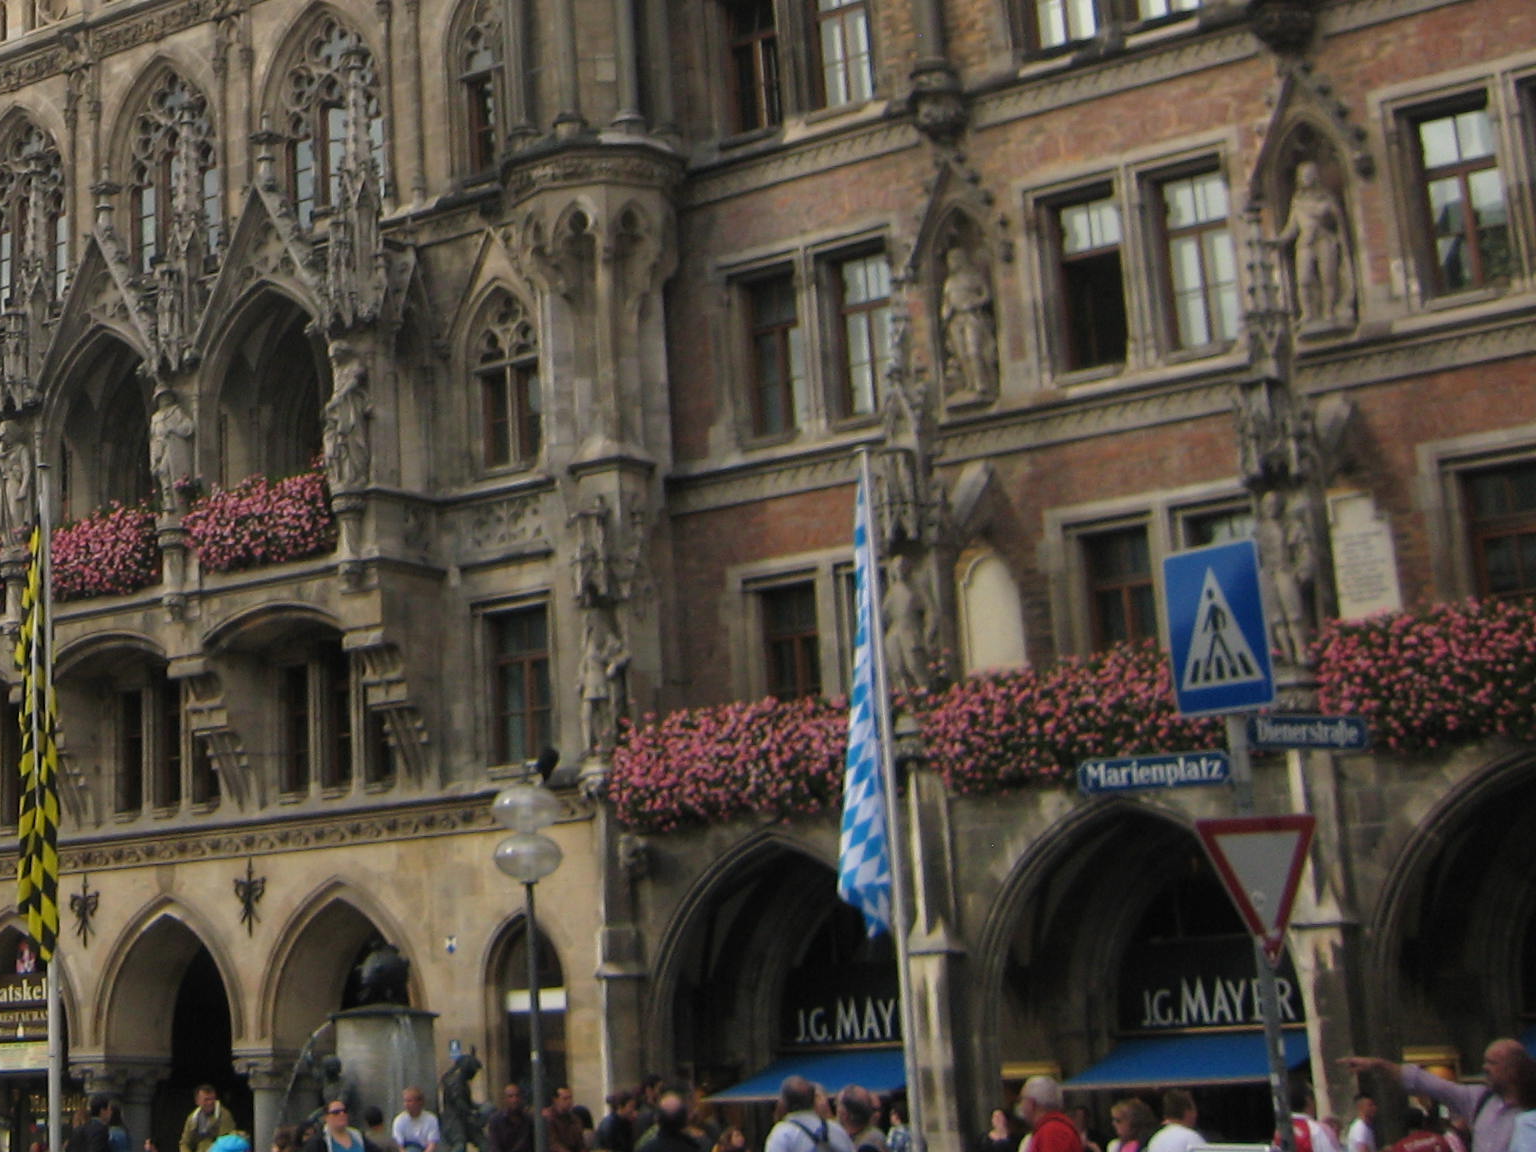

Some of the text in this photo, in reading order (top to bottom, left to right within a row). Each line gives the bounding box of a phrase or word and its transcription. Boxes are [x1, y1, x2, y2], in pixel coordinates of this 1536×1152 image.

[1255, 717, 1359, 747] Dienerstraße
[1085, 756, 1223, 788] Marienplatz
[834, 995, 900, 1041] MAY
